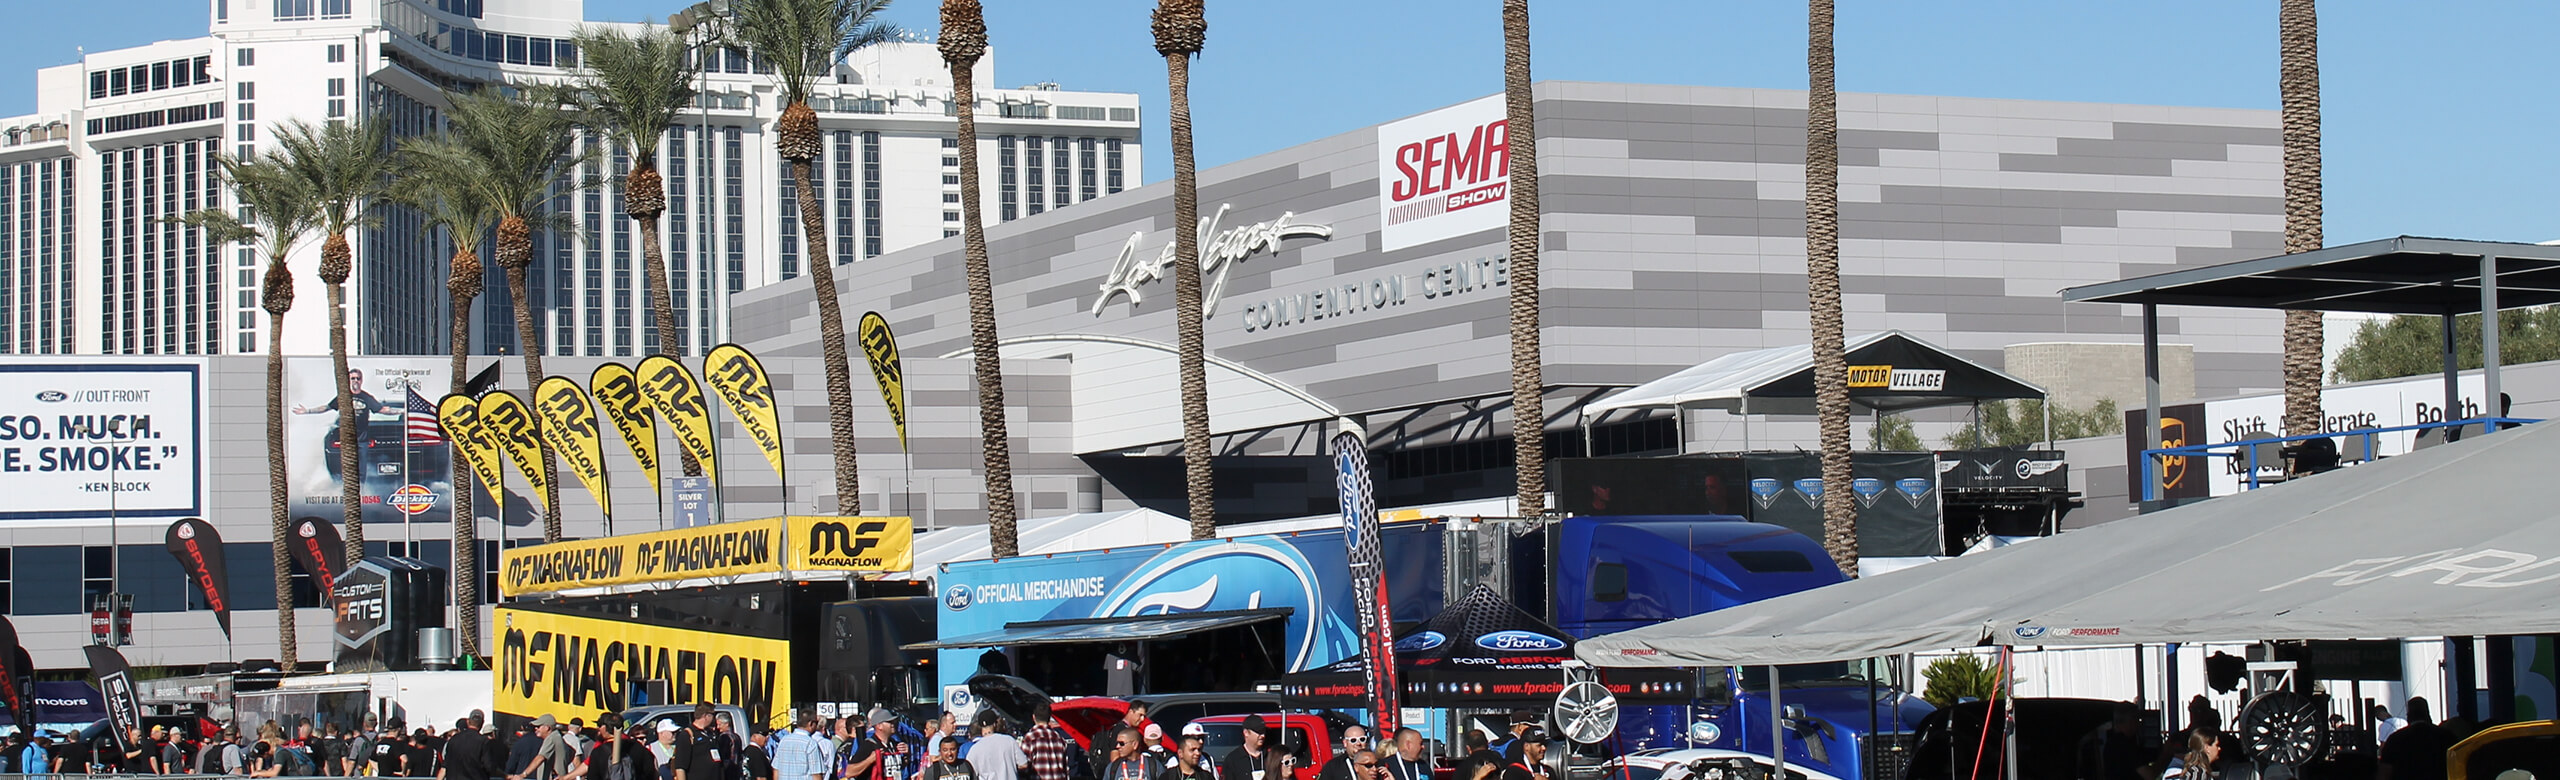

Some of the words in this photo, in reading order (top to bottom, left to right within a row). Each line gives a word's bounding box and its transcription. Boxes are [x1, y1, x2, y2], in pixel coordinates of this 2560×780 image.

[1392, 119, 1510, 201] SEMA
[1448, 185, 1504, 208] SHOW
[1196, 203, 1333, 320] Vegas
[1241, 274, 1406, 333] CONVENTION
[1421, 253, 1509, 299] CENTE
[861, 338, 903, 427] MAGNAFLOW
[1850, 369, 1888, 383] MOTOR
[1892, 373, 1942, 387] VILLAGE
[39, 390, 64, 402] Ford
[86, 390, 110, 402] OUT
[112, 390, 151, 402] FRONT
[2416, 397, 2478, 425] Both
[0, 415, 50, 440] SO.
[59, 414, 161, 440] MUCH.
[640, 381, 712, 461] MAGNAFLOW
[708, 371, 778, 454] MAGNAFLOW
[2223, 415, 2267, 443] Shift
[2277, 409, 2381, 438] Alerate.
[539, 401, 599, 479] MAGNAFLOW
[595, 388, 656, 471] MAGNAFLOW
[442, 415, 499, 488] MAGNAFLOW
[482, 415, 545, 488] MAGNAFLOW
[2161, 439, 2182, 477] ps
[86, 482, 109, 492] KEN
[113, 481, 151, 492] BLOCK
[305, 496, 320, 504] VISIT
[322, 496, 330, 504] US
[678, 493, 703, 501] SILVER
[683, 502, 697, 510] LOT
[687, 513, 694, 527] 1
[306, 538, 334, 599] SPYD
[530, 544, 624, 585] MAGNAFLOW
[664, 528, 770, 573] MAGNAFLOW
[809, 558, 882, 567] MAGNAFLOW
[185, 539, 224, 613] SPYDER
[341, 584, 372, 598] CUSTOM
[948, 587, 969, 607] Ford
[976, 582, 1023, 605] OFFICIAL
[1024, 576, 1105, 601] MERCHANDISE
[1361, 577, 1375, 628] FORD
[1353, 578, 1367, 635] RACING
[1362, 638, 1375, 702] SCHOOL
[1496, 634, 1549, 648] Ford
[2069, 627, 2120, 636] PERFORMANCE
[1452, 657, 1497, 665] FORD
[35, 696, 89, 707] motors
